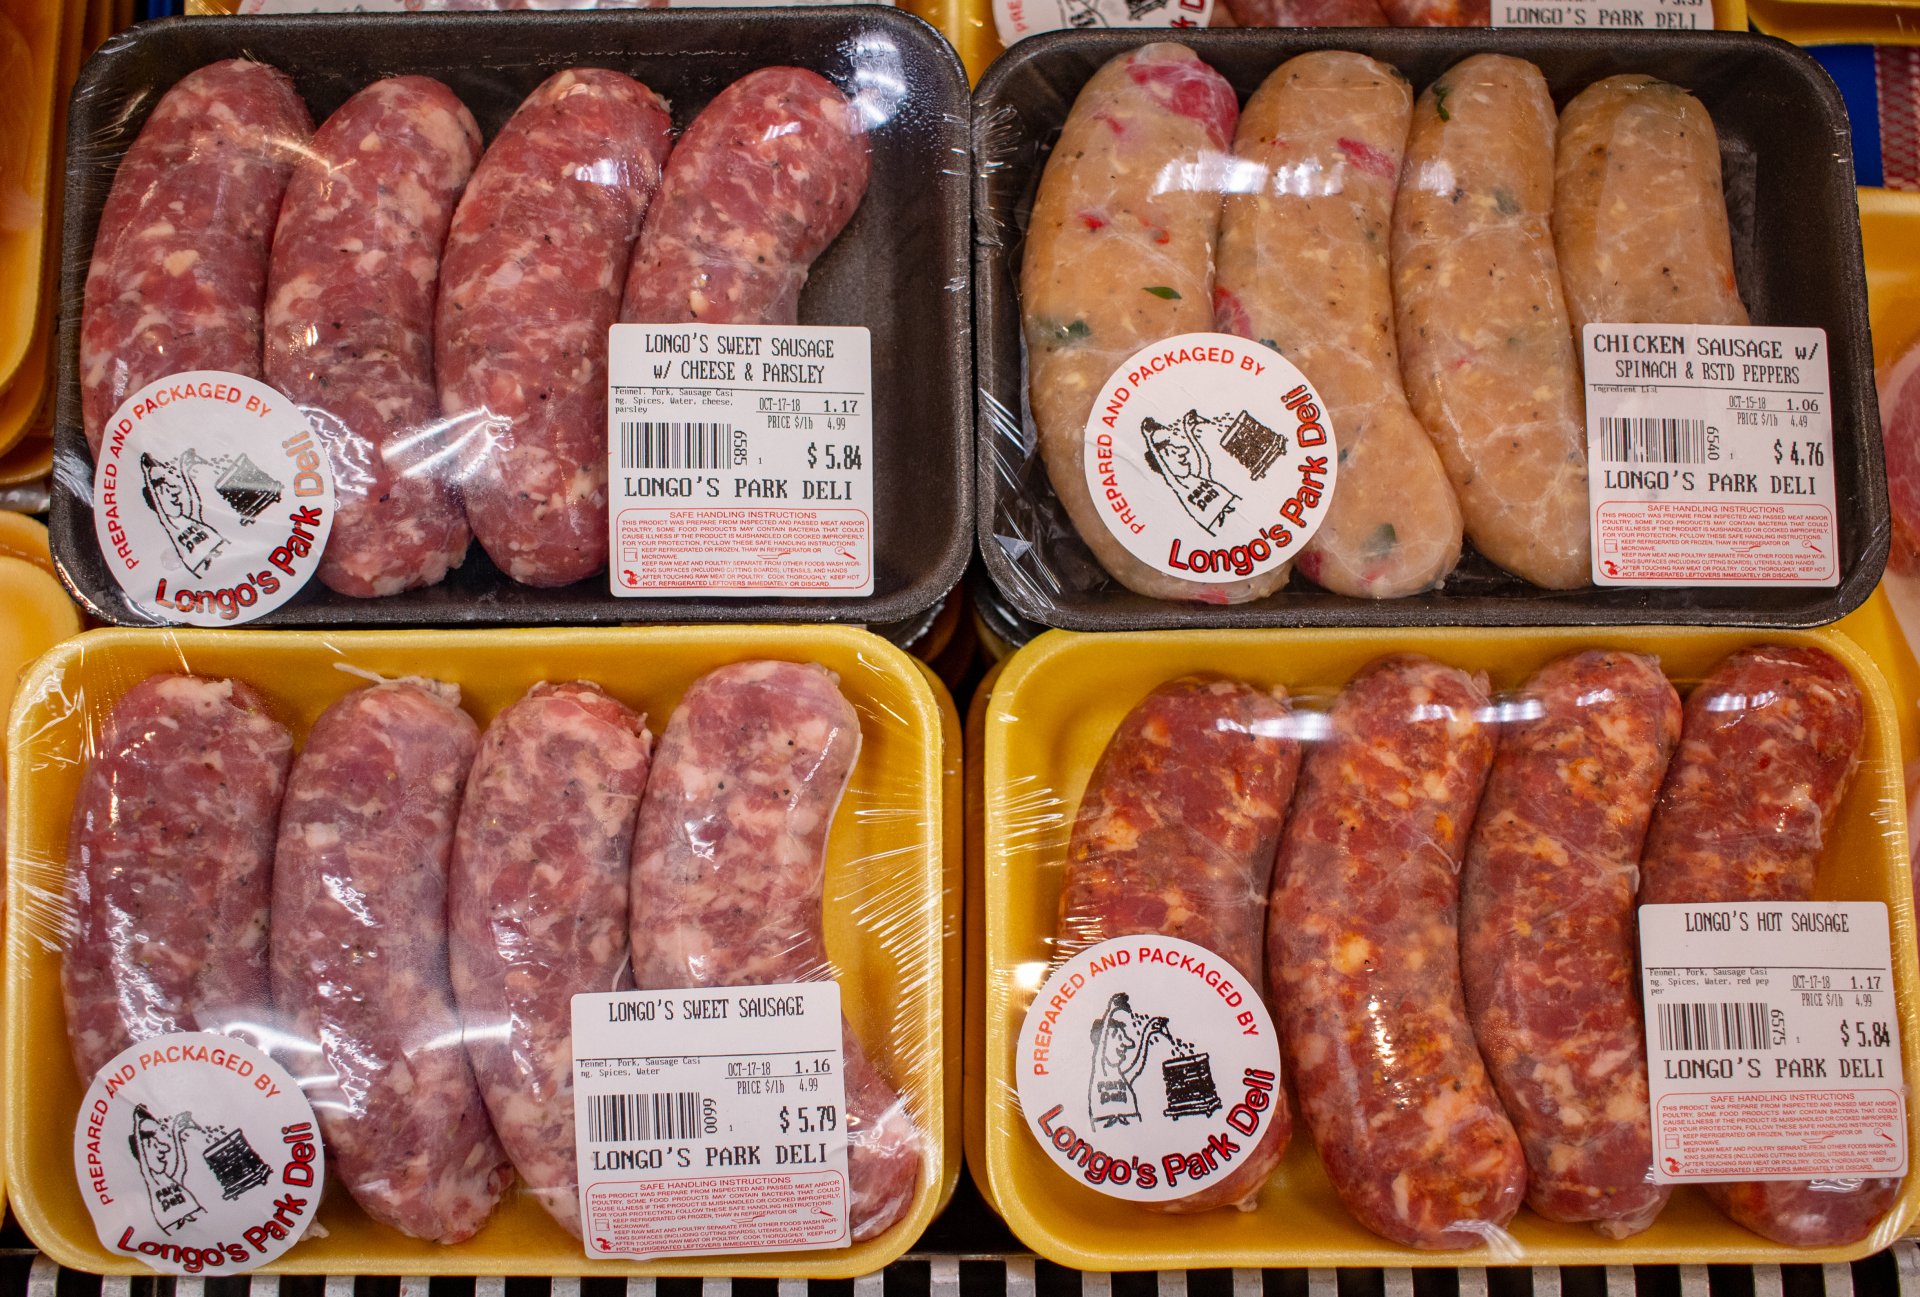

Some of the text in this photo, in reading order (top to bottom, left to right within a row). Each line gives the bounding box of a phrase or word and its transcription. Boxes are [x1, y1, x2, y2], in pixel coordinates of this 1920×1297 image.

[1505, 7, 1587, 26] LONGO'S
[1599, 11, 1644, 26] PARK
[645, 333, 834, 358] LONGO'S SWEET SAUSAGE
[1594, 334, 1685, 354] CHICKEN
[1696, 337, 1783, 359] SAUSAGE
[681, 361, 736, 381] CHEESE
[745, 363, 754, 381] &
[762, 363, 825, 384] PARSLEY
[1615, 360, 1800, 384] SPINACH & RSTD PEPPERS
[132, 382, 242, 420] PACKAGED
[679, 388, 712, 397] Sausage
[715, 389, 733, 397] Casi
[1729, 395, 1819, 411] OCT-15-18 1.06
[245, 395, 272, 418] BY
[615, 405, 648, 414] parsley
[759, 397, 858, 413] OCT-17-18 1.17
[767, 416, 790, 429] PRICE
[827, 417, 846, 430] 4.99
[1737, 412, 1758, 425] PRICE
[1790, 415, 1808, 427] 4.49
[110, 417, 133, 459] AND
[733, 430, 748, 465] 6585
[1097, 346, 1266, 535] PREPARED AND PACKAGED BY
[1706, 426, 1720, 460] 6540
[281, 430, 325, 497] Deli
[624, 476, 852, 500] LONGO'S PARK DELI
[1168, 384, 1328, 576] Longo's Park Deli
[1604, 469, 1816, 495] LONGO'S PARK DELI
[103, 462, 140, 571] PREPARED
[747, 511, 817, 519] INSTRUCTIONS
[1720, 505, 1784, 513] INSTRUCTIONS
[268, 505, 323, 577] Park
[155, 570, 280, 620] Longo's
[1685, 910, 1850, 933] LONGO'S HOT SAUSAGE
[1713, 968, 1746, 977] Sausage
[1750, 968, 1768, 976] Casi
[1755, 978, 1770, 986] pep
[1792, 975, 1881, 990] OCT-17-18 1.17
[608, 996, 805, 1022] LONGO'S SWEET SAUSAGE
[1033, 947, 1260, 1076] PREPARED AND PACKAGED BY
[1801, 994, 1823, 1007] PRICE
[1855, 994, 1872, 1007] 4.99
[1770, 1009, 1786, 1045] 6575
[636, 1067, 660, 1076] Water
[645, 1058, 678, 1066] Sausage
[727, 1059, 831, 1076] OCT-17-18 1.16
[1664, 1057, 1884, 1079] LONGO'S PARK DELI
[737, 1080, 761, 1094] PRICE
[799, 1078, 819, 1092] 4.99
[1738, 1094, 1787, 1102] HANDLING
[1789, 1093, 1855, 1101] INSTRUCTIONS
[87, 1045, 281, 1205] PREPARED AND PACKAGED BY
[703, 1098, 718, 1134] 6600
[1037, 1067, 1276, 1189] Longo's Park Deli
[593, 1143, 827, 1170] LONGO'S PARK DELI
[640, 1176, 791, 1190] SAFE HANDLING INSTRUCTIONS
[117, 1121, 316, 1274] Longo's Park Deli
